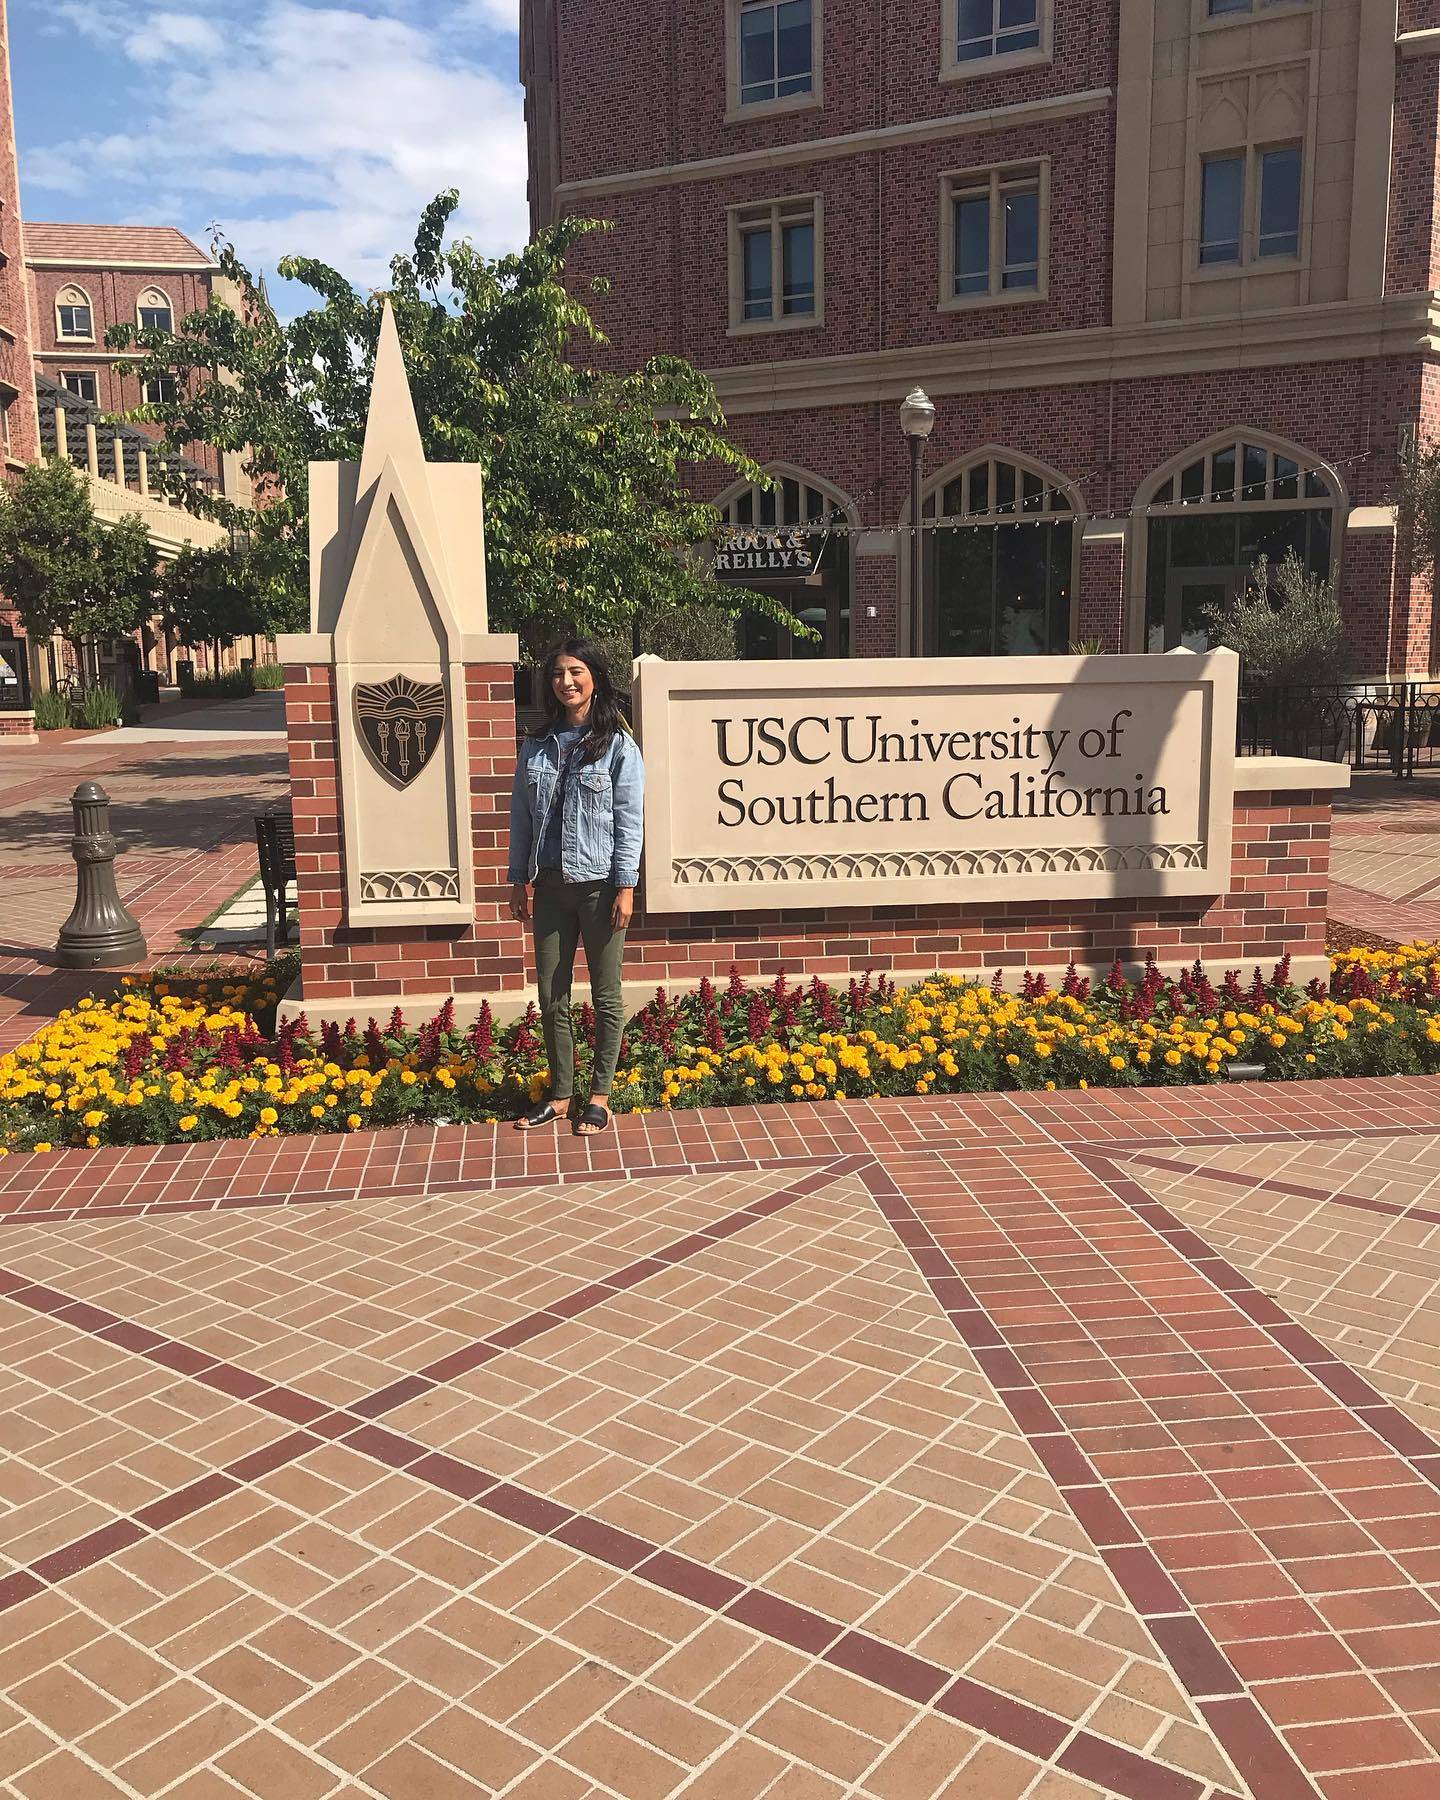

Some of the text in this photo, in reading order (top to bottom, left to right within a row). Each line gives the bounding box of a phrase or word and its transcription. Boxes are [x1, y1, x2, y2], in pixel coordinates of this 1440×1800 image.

[717, 550, 811, 570] REILLY'S
[712, 709, 1132, 776] USC University of
[717, 770, 1171, 827] Southern California
